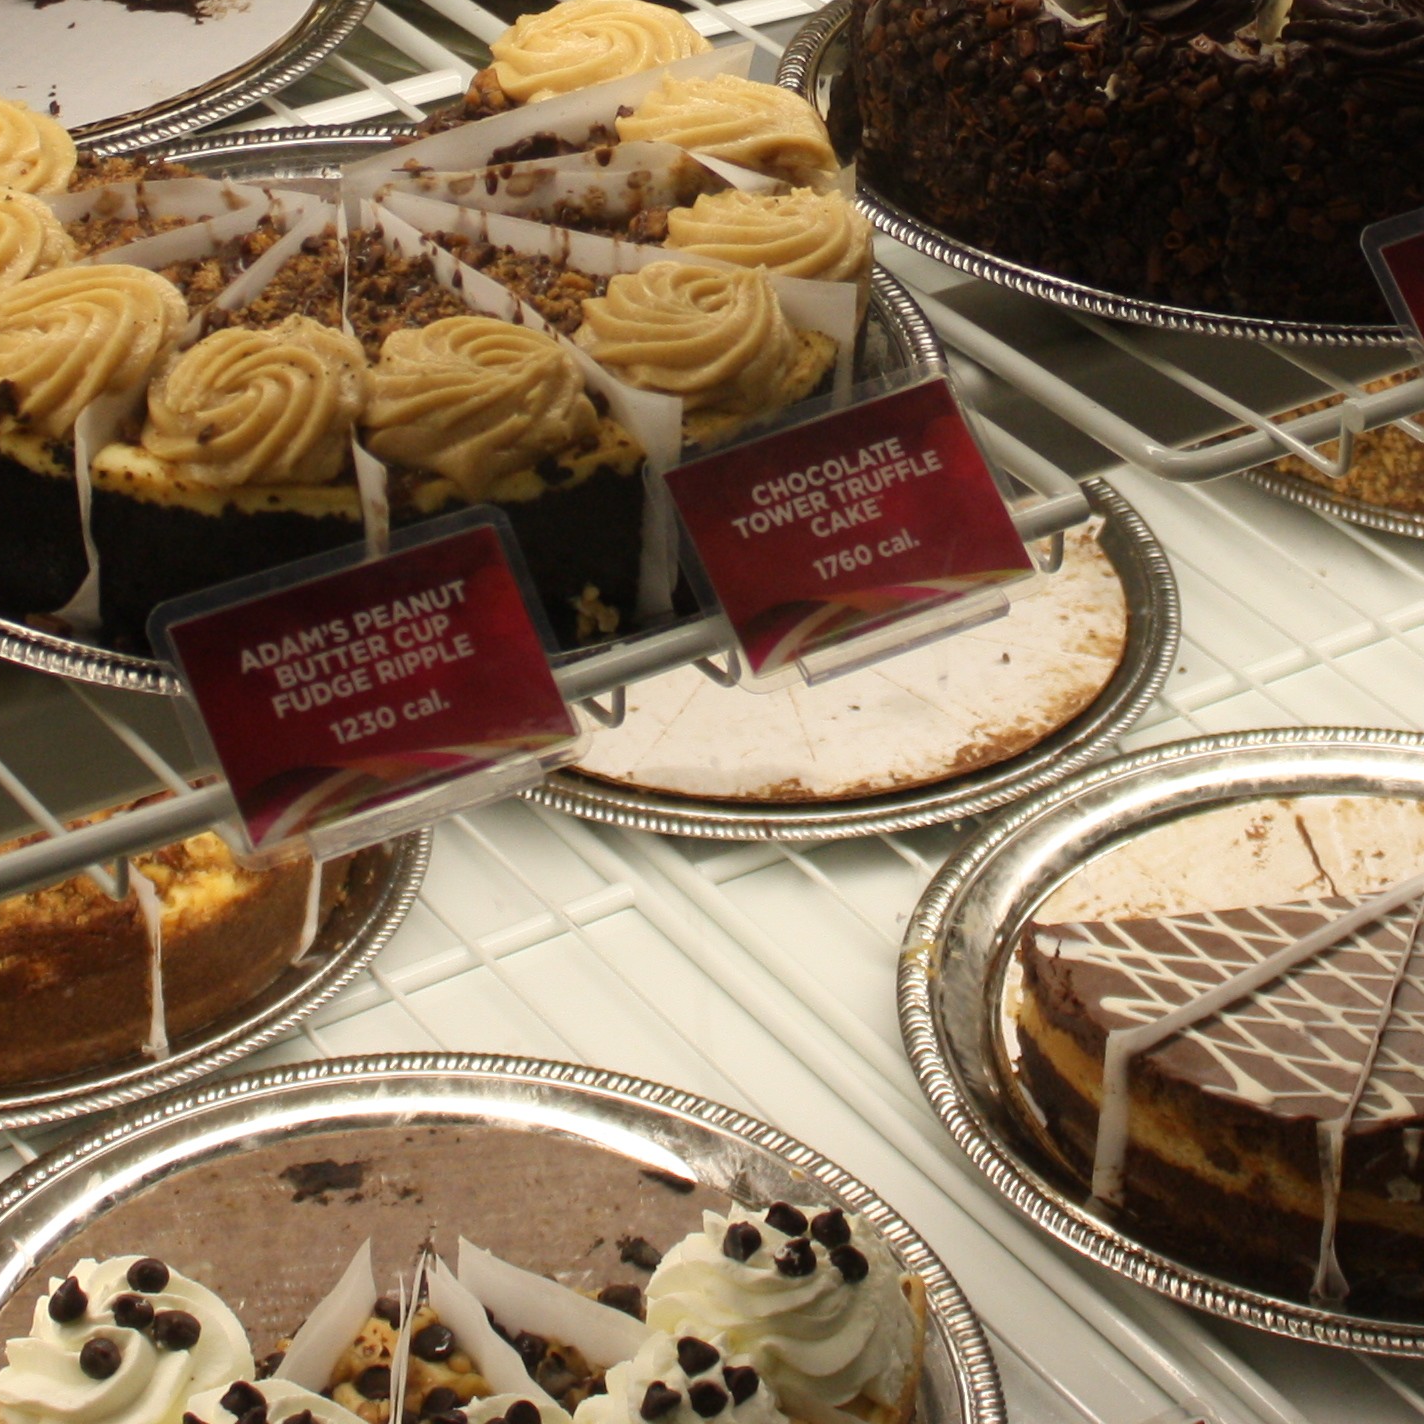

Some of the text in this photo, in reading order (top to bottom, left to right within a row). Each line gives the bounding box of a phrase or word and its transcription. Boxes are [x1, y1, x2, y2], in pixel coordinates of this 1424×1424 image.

[731, 450, 944, 539] TOWER TRUFFLE
[750, 436, 908, 505] CHOCOLATE
[813, 530, 921, 581] 1760 cal.
[240, 580, 467, 675] ADAM'S PEANUT
[275, 612, 452, 690] BUTTER CUP
[272, 632, 474, 720] FUDGE RIPPLE
[329, 691, 450, 745] 1230 cal.
